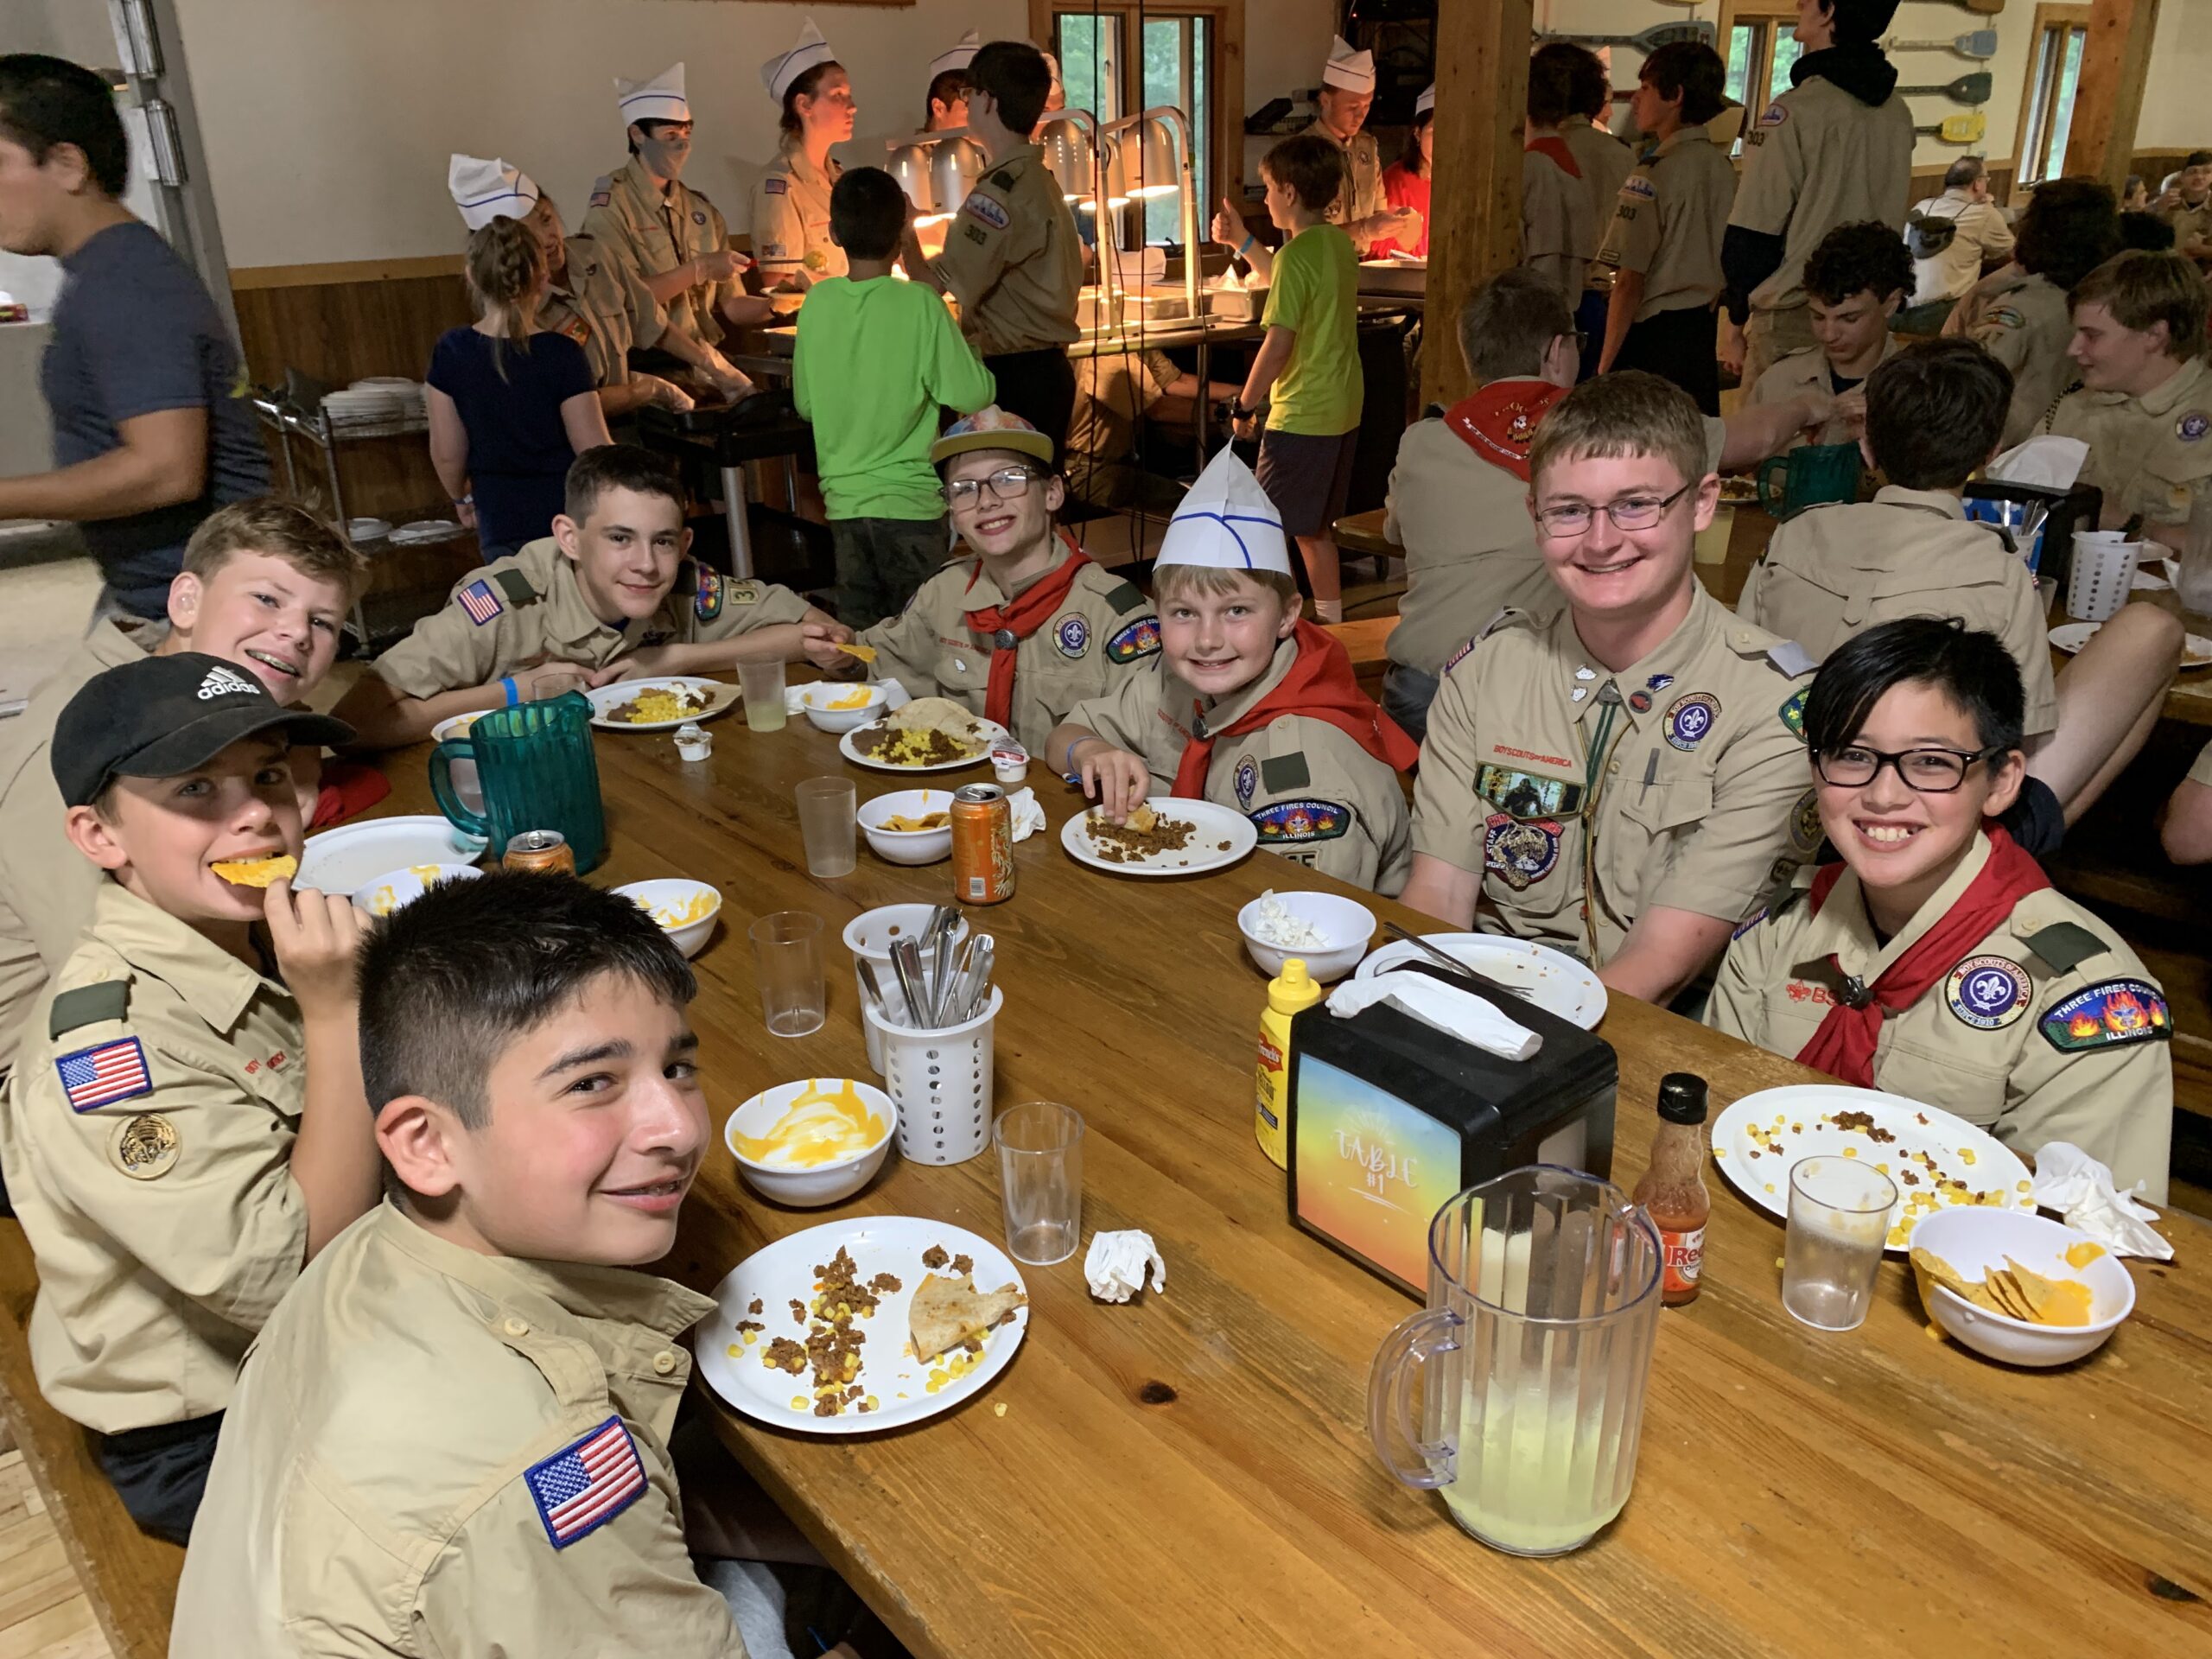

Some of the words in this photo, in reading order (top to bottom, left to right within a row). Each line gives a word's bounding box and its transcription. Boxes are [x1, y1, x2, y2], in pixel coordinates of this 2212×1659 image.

[197, 681, 261, 700] adidas
[1255, 806, 1280, 820] THREE
[1281, 802, 1304, 811] FIRES
[1306, 802, 1338, 815] COUNCIL
[1282, 830, 1315, 840] ILLINOIS
[1486, 829, 1497, 854] STAFF
[1974, 958, 2005, 968] SCOUTS
[2054, 994, 2093, 1018] THREE
[2094, 983, 2126, 998] FIRES
[2105, 1026, 2153, 1040] ILLINOIS
[1333, 1128, 1418, 1188] TABLE
